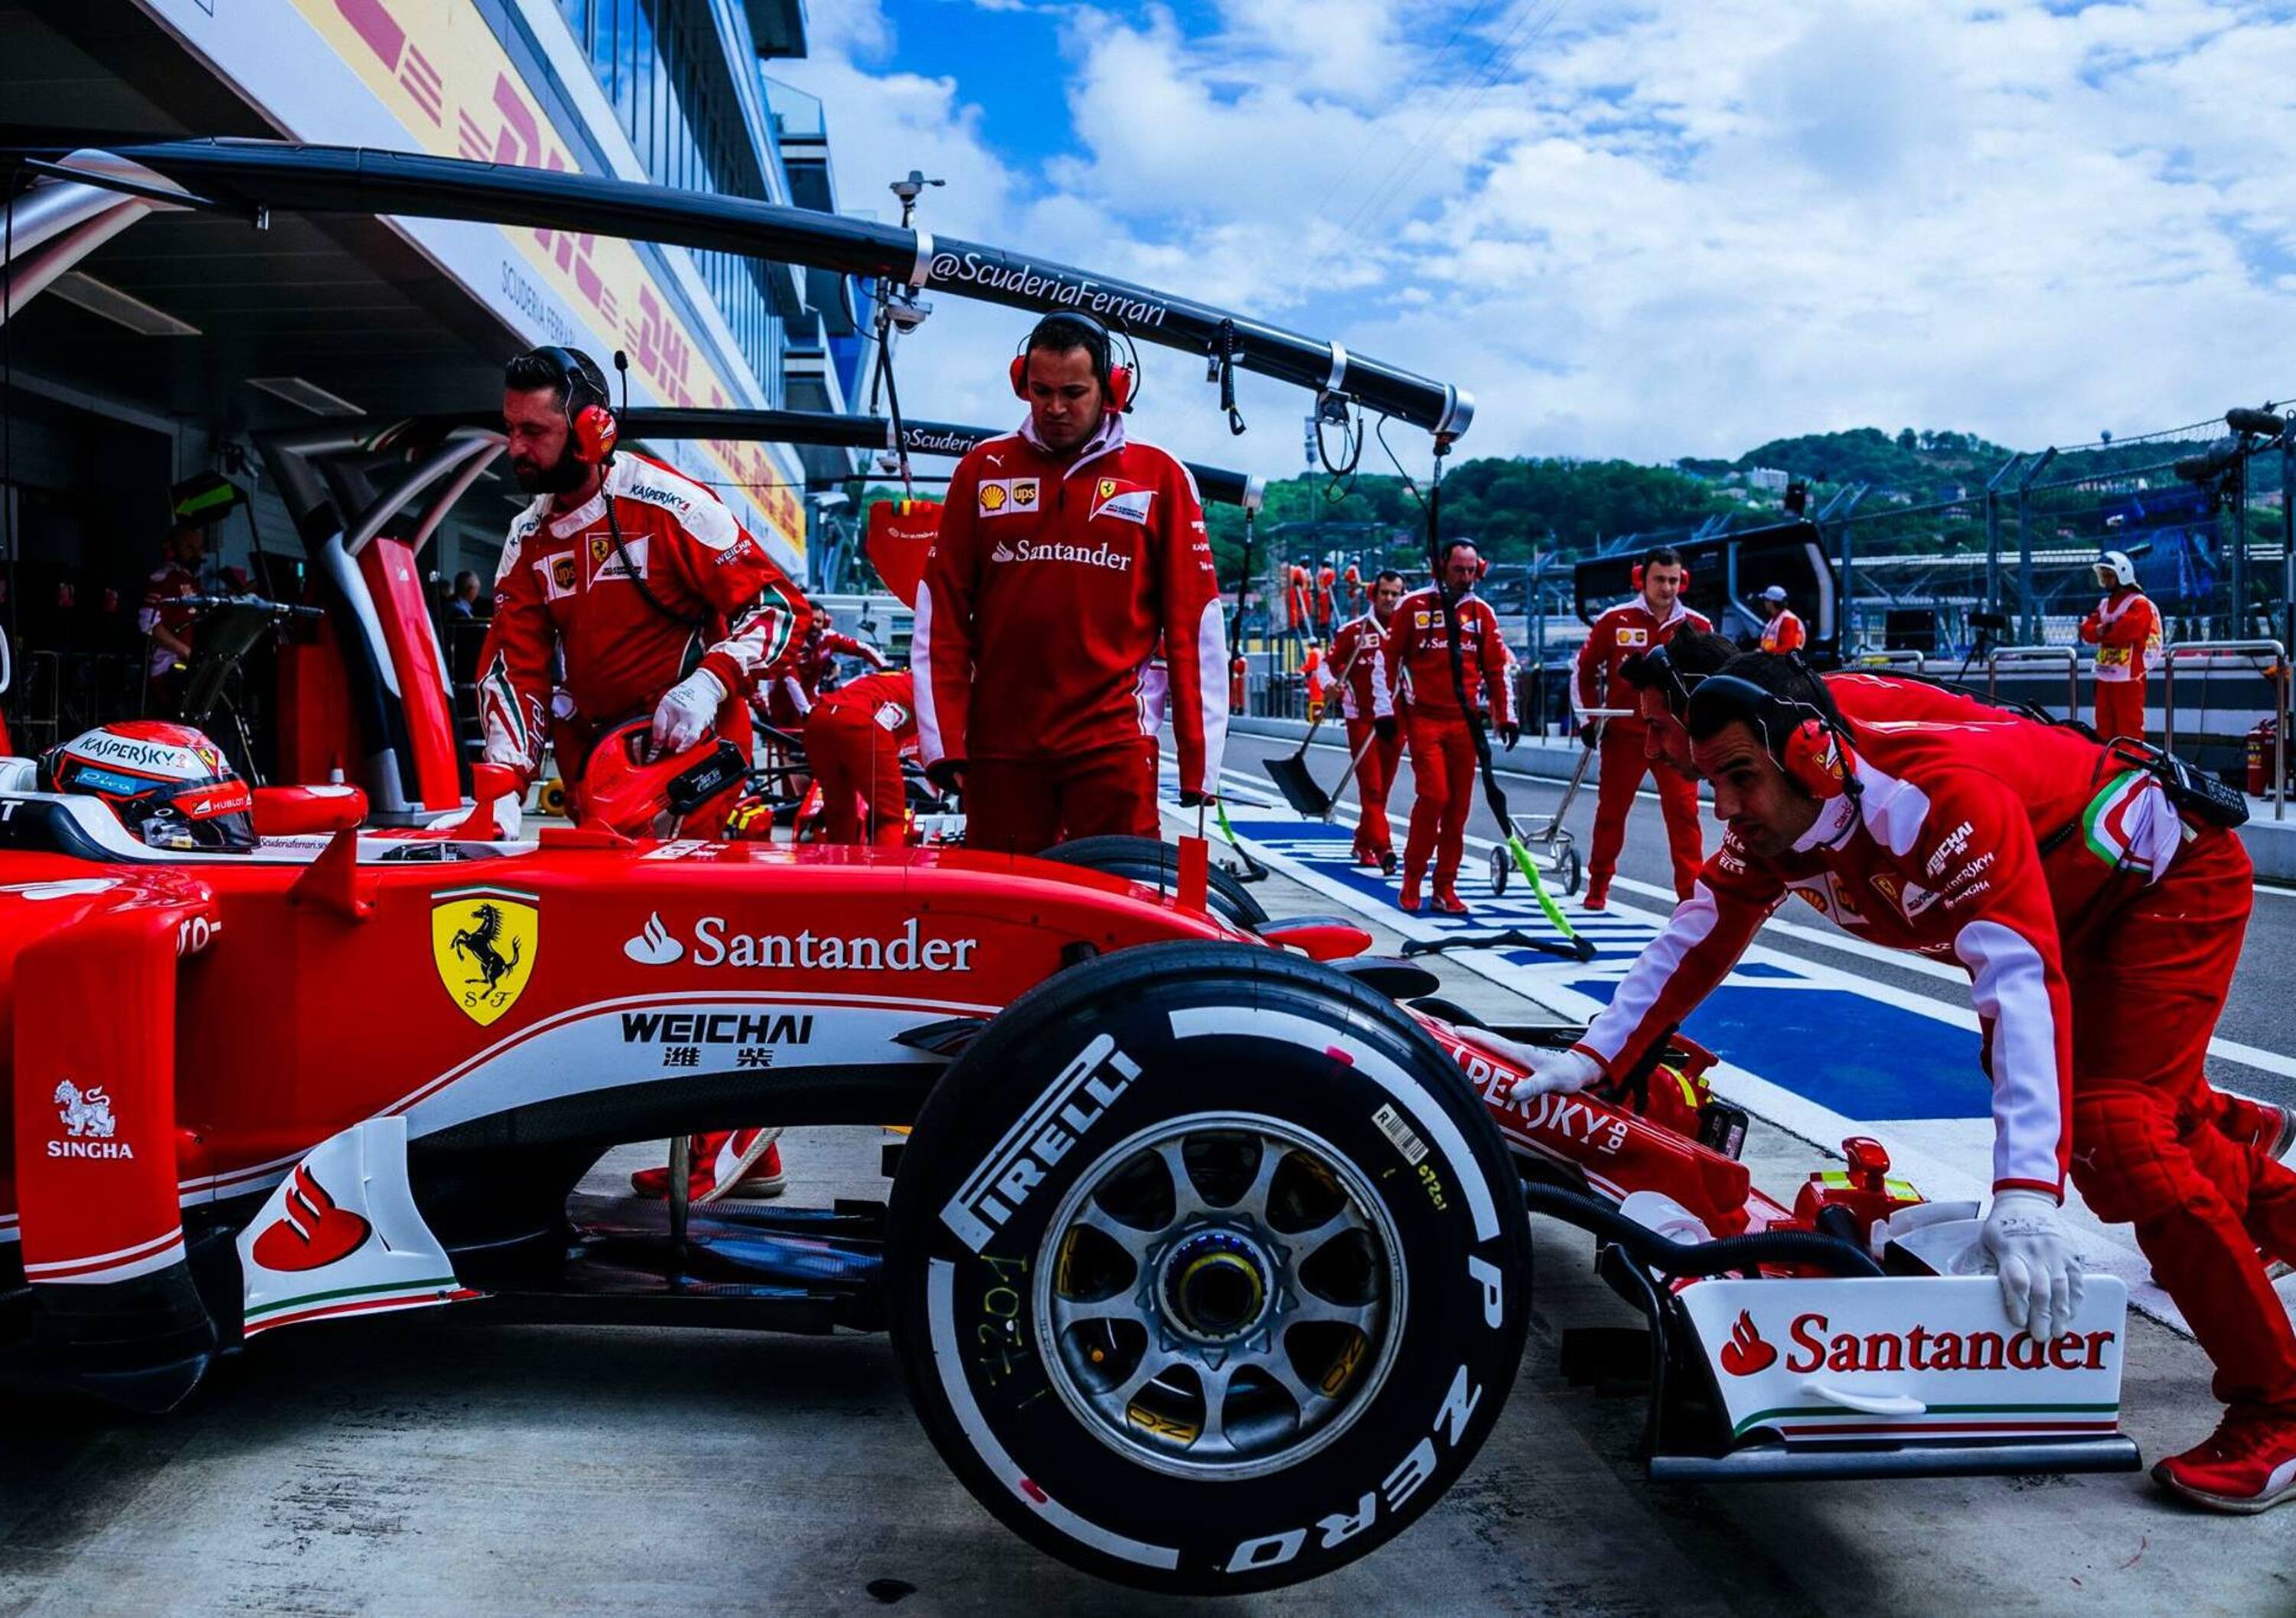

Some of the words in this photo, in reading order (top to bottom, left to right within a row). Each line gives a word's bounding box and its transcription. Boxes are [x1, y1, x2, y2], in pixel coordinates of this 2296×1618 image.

[929, 253, 1167, 326] @ScuderiaFerrari
[630, 483, 685, 507] KASPERSKY
[1014, 488, 1035, 503] ups
[1016, 540, 1131, 571] Santander
[80, 737, 174, 765] KASPERSKY
[213, 798, 245, 810] HUBLOT
[693, 917, 977, 972] Santander
[465, 991, 478, 1008] S
[621, 1014, 814, 1044] WEICHAI
[1378, 1111, 1390, 1124] R
[47, 1140, 133, 1159] SINGHA
[939, 1032, 1143, 1254] PIRELLI
[1598, 1121, 1628, 1155] lab
[1468, 1254, 1502, 1329] P
[1785, 1313, 2115, 1374] Santander
[1226, 1365, 1481, 1572] ZERO
